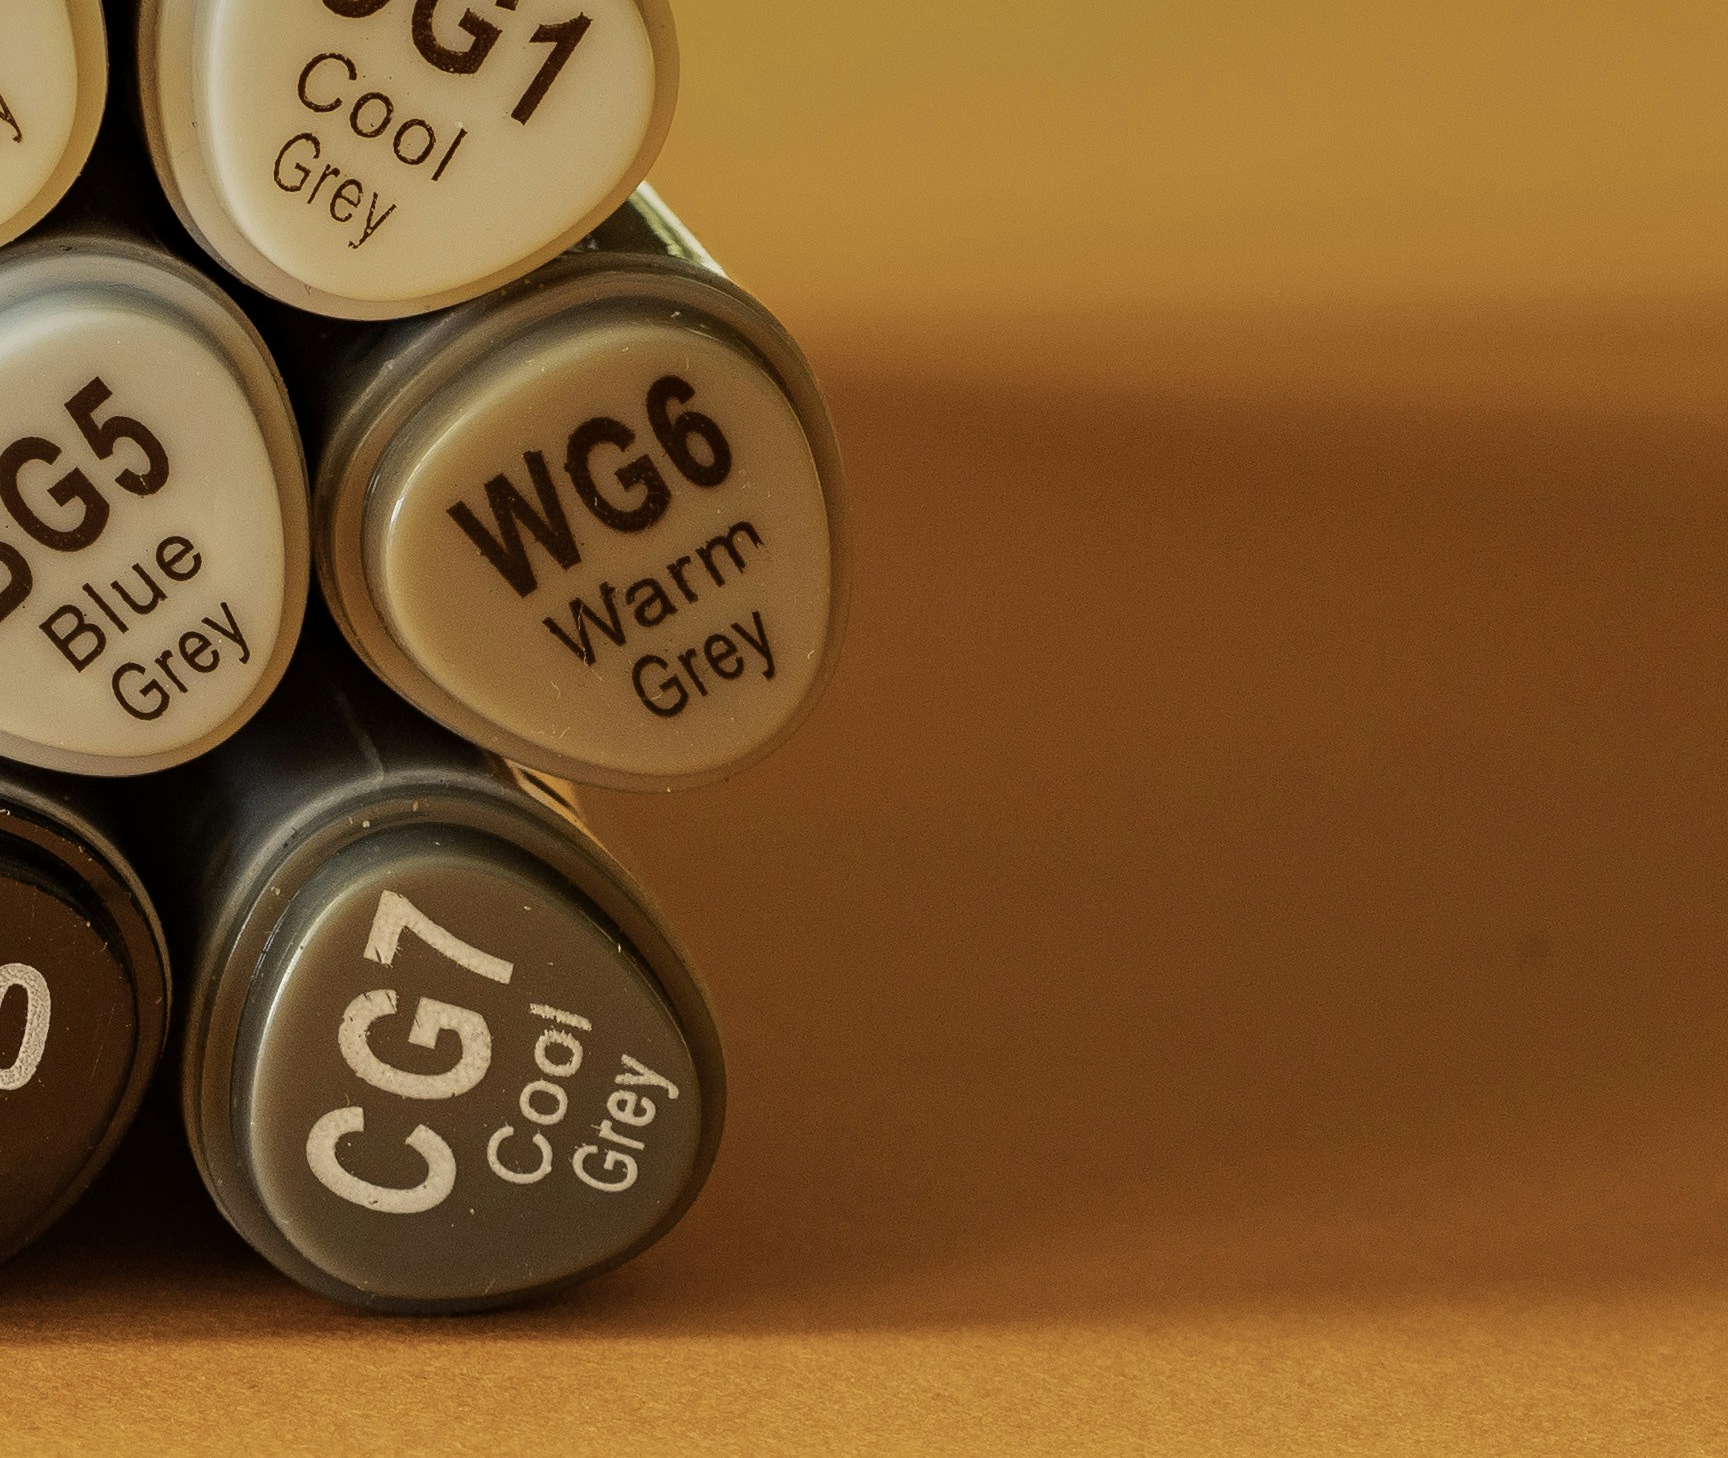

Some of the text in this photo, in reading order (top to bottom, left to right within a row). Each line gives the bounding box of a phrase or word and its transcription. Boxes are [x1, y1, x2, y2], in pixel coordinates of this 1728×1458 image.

[297, 53, 468, 181] Cool
[273, 133, 396, 249] Grey
[446, 374, 731, 599] WG6
[38, 535, 202, 673] Blue
[111, 602, 250, 720] Grey
[542, 520, 764, 666] Warm
[631, 610, 777, 718] Grey
[305, 890, 514, 1214] CG7
[486, 1002, 592, 1185] Cool
[572, 1053, 680, 1193] Grey
